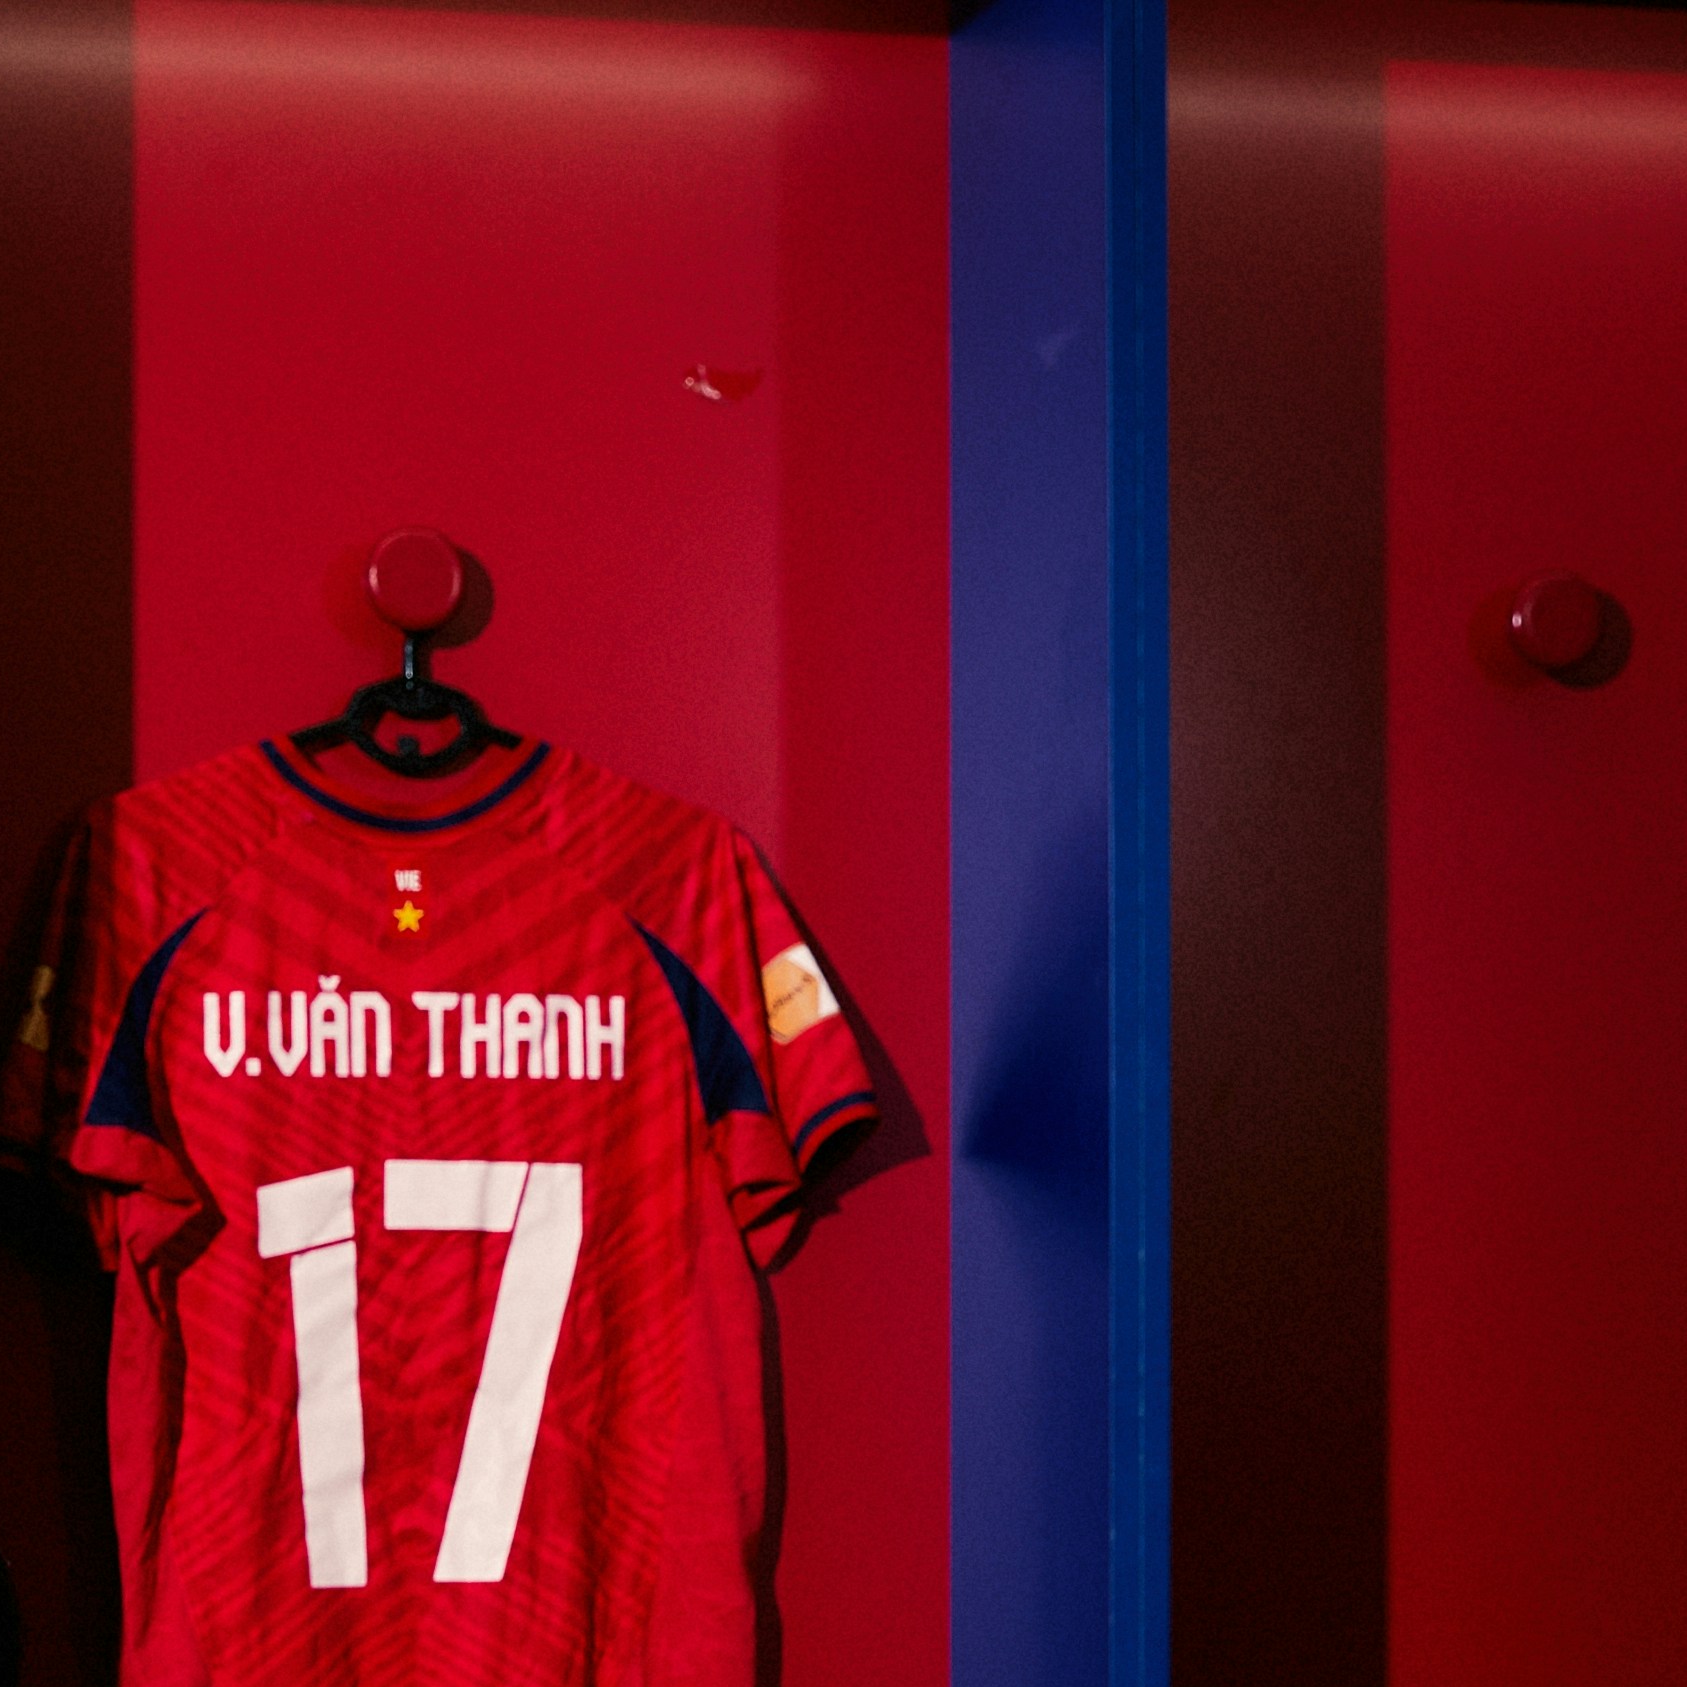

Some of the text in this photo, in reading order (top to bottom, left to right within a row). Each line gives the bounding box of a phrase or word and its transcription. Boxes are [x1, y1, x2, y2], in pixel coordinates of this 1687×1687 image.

[202, 974, 626, 1081] V.VĂN THANH
[256, 1158, 583, 1589] 17
